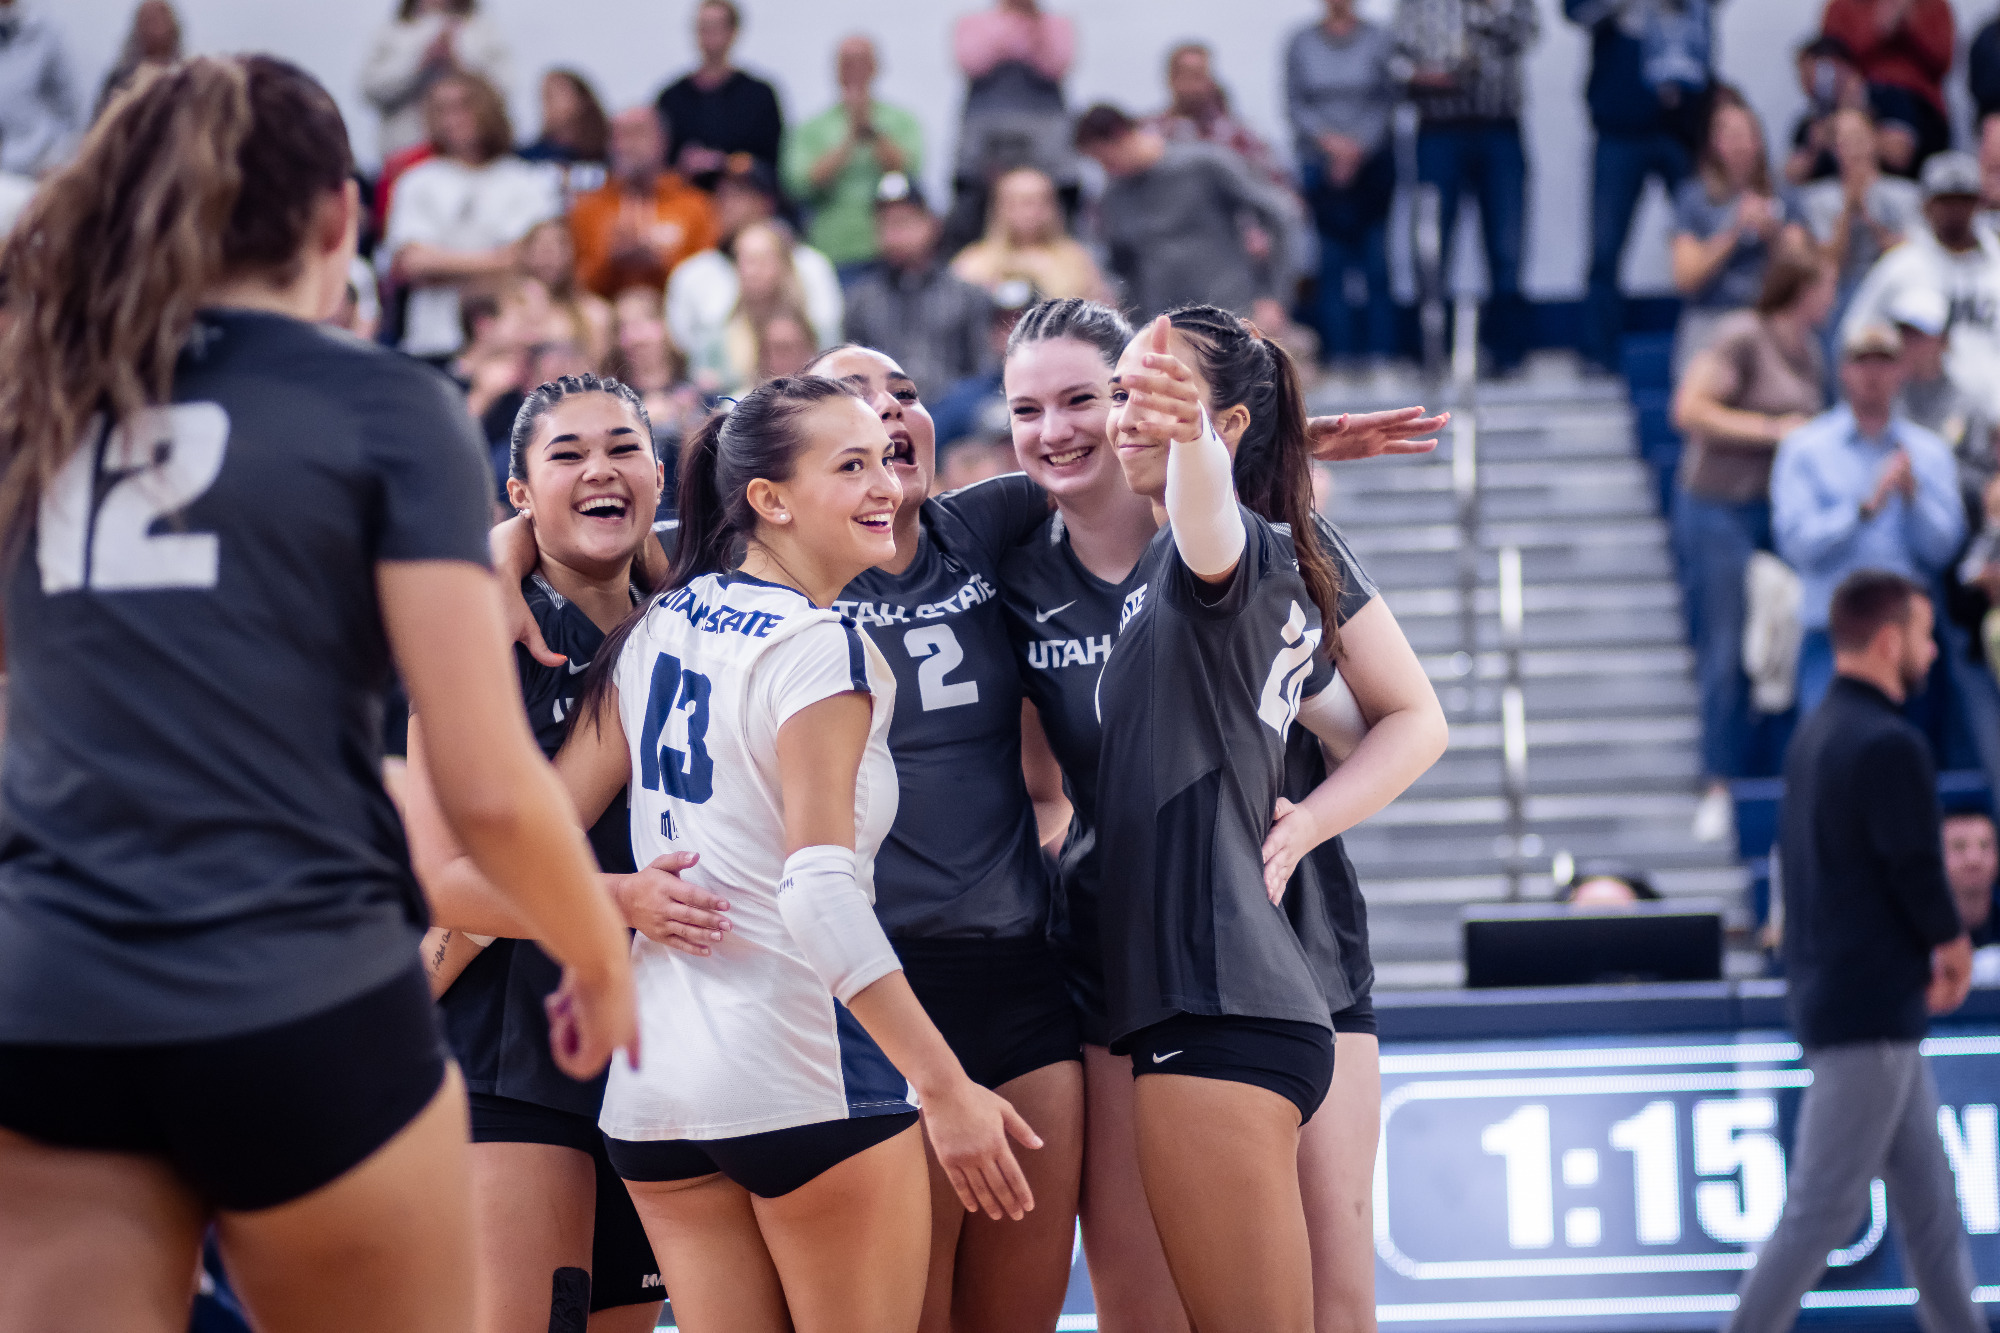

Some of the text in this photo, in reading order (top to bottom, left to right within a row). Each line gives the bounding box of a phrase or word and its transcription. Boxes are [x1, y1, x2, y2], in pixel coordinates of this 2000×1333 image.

[37, 400, 231, 595] 12
[640, 651, 714, 804] 13
[903, 623, 980, 712] 2
[1028, 634, 1112, 669] UTAH
[1481, 1097, 1788, 1250] 1:15
